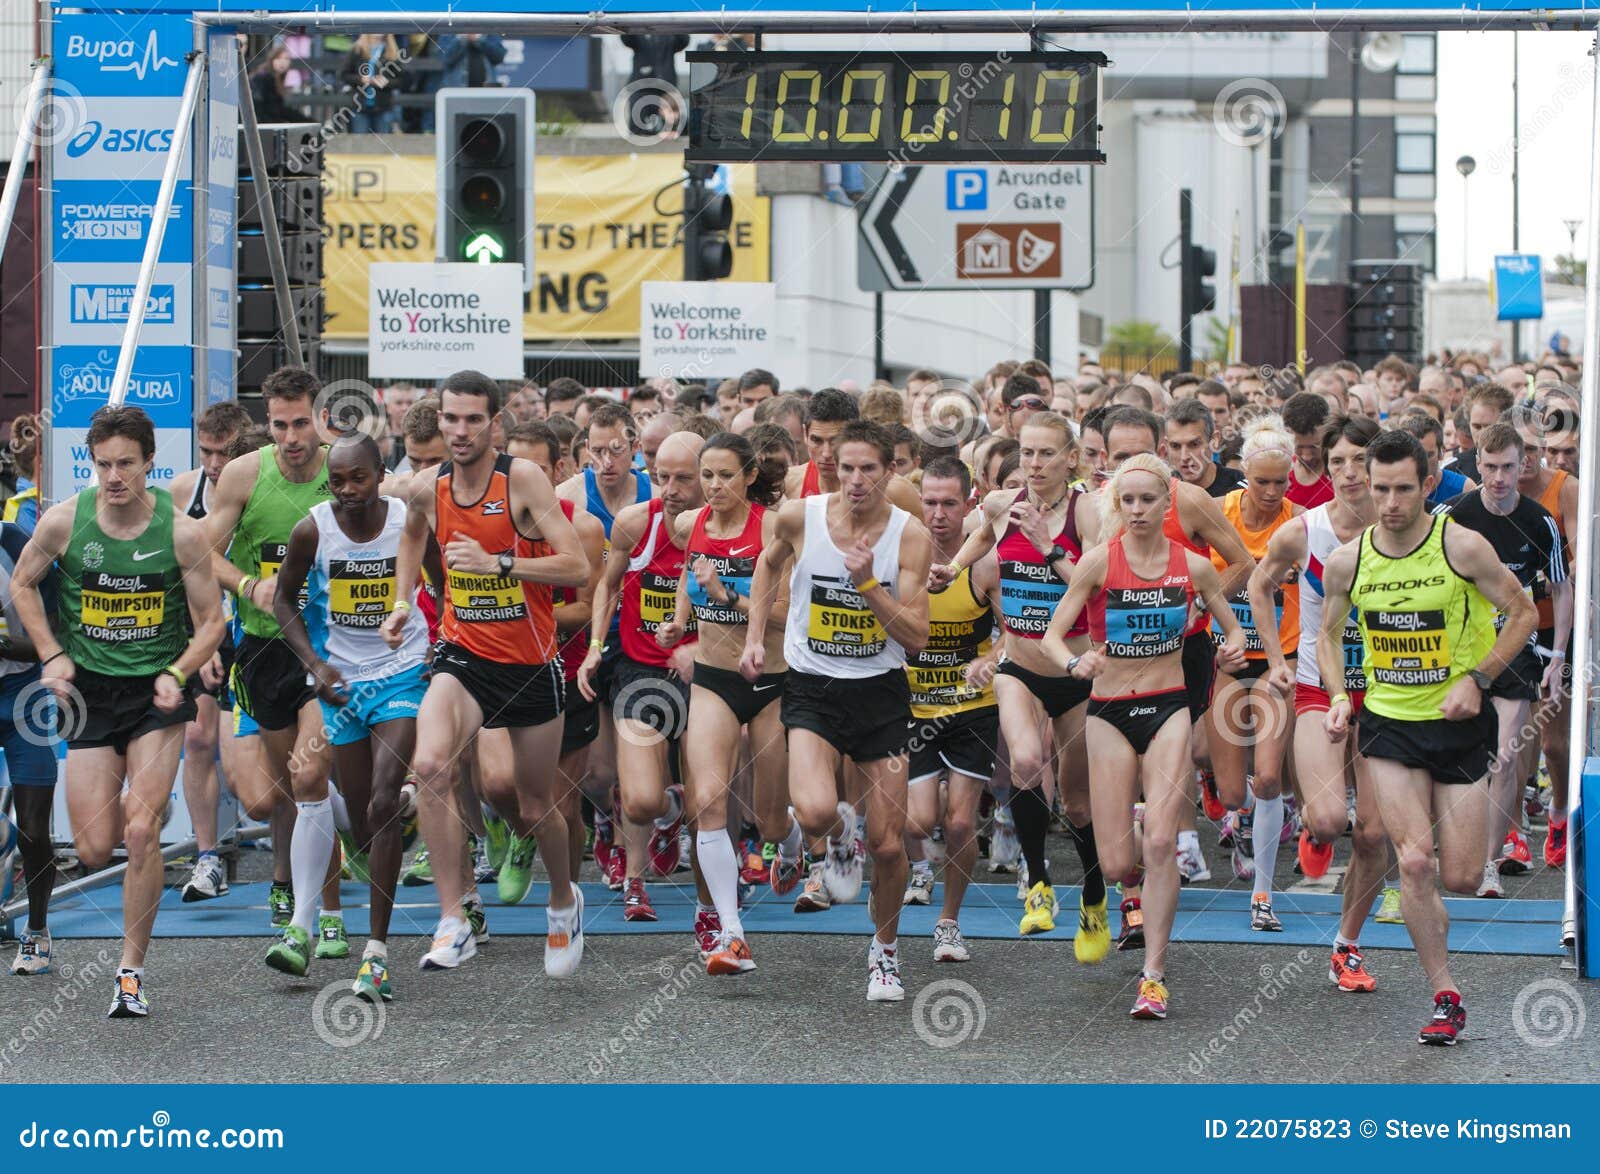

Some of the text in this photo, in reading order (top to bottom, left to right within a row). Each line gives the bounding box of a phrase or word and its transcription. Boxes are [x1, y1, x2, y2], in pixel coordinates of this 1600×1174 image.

[67, 35, 135, 62] Bupa
[741, 70, 1080, 143] 10.00.10
[103, 129, 174, 152] asics
[997, 168, 1082, 185] Arundel
[955, 173, 983, 208] P
[1014, 193, 1067, 209] Gate
[62, 205, 183, 219] POWERAE
[320, 224, 419, 249] PPERS
[377, 287, 480, 309] Welcome
[651, 302, 741, 320] Welcome
[380, 312, 511, 334] to Yorkshire
[653, 322, 767, 341] to Yorkshire
[380, 340, 475, 352] yorkshire.com
[128, 380, 174, 398] PURA
[73, 465, 91, 479] to
[346, 561, 381, 575] Bupa
[1014, 561, 1046, 577] Bupa
[98, 573, 135, 589] Bupa
[449, 575, 518, 591] LEMONCELLO
[654, 576, 680, 589] Bup
[1359, 576, 1446, 594] BROOKS
[350, 583, 389, 599] KOGO
[825, 589, 863, 605] Bupa
[1122, 590, 1158, 604] Bupa
[84, 594, 162, 613] THOMPSON
[506, 596, 513, 605] 3
[645, 594, 676, 609] HUDS
[455, 605, 523, 621] YORKSHIRE
[821, 611, 875, 629] STOKES
[1379, 612, 1413, 627] Bupa
[1006, 617, 1050, 632] YORKSH
[1127, 614, 1167, 629] STEEL
[85, 625, 160, 641] YORKSHIRE
[1143, 634, 1160, 642] asics
[811, 639, 883, 656] YORKSHIRE
[1110, 637, 1180, 656] YORKSHIRE
[1372, 635, 1442, 653] CONNOLLY
[919, 652, 951, 664] Bupa
[1431, 659, 1439, 668] 8
[1375, 668, 1447, 683] YORKSHIRE
[1138, 706, 1157, 715] asics
